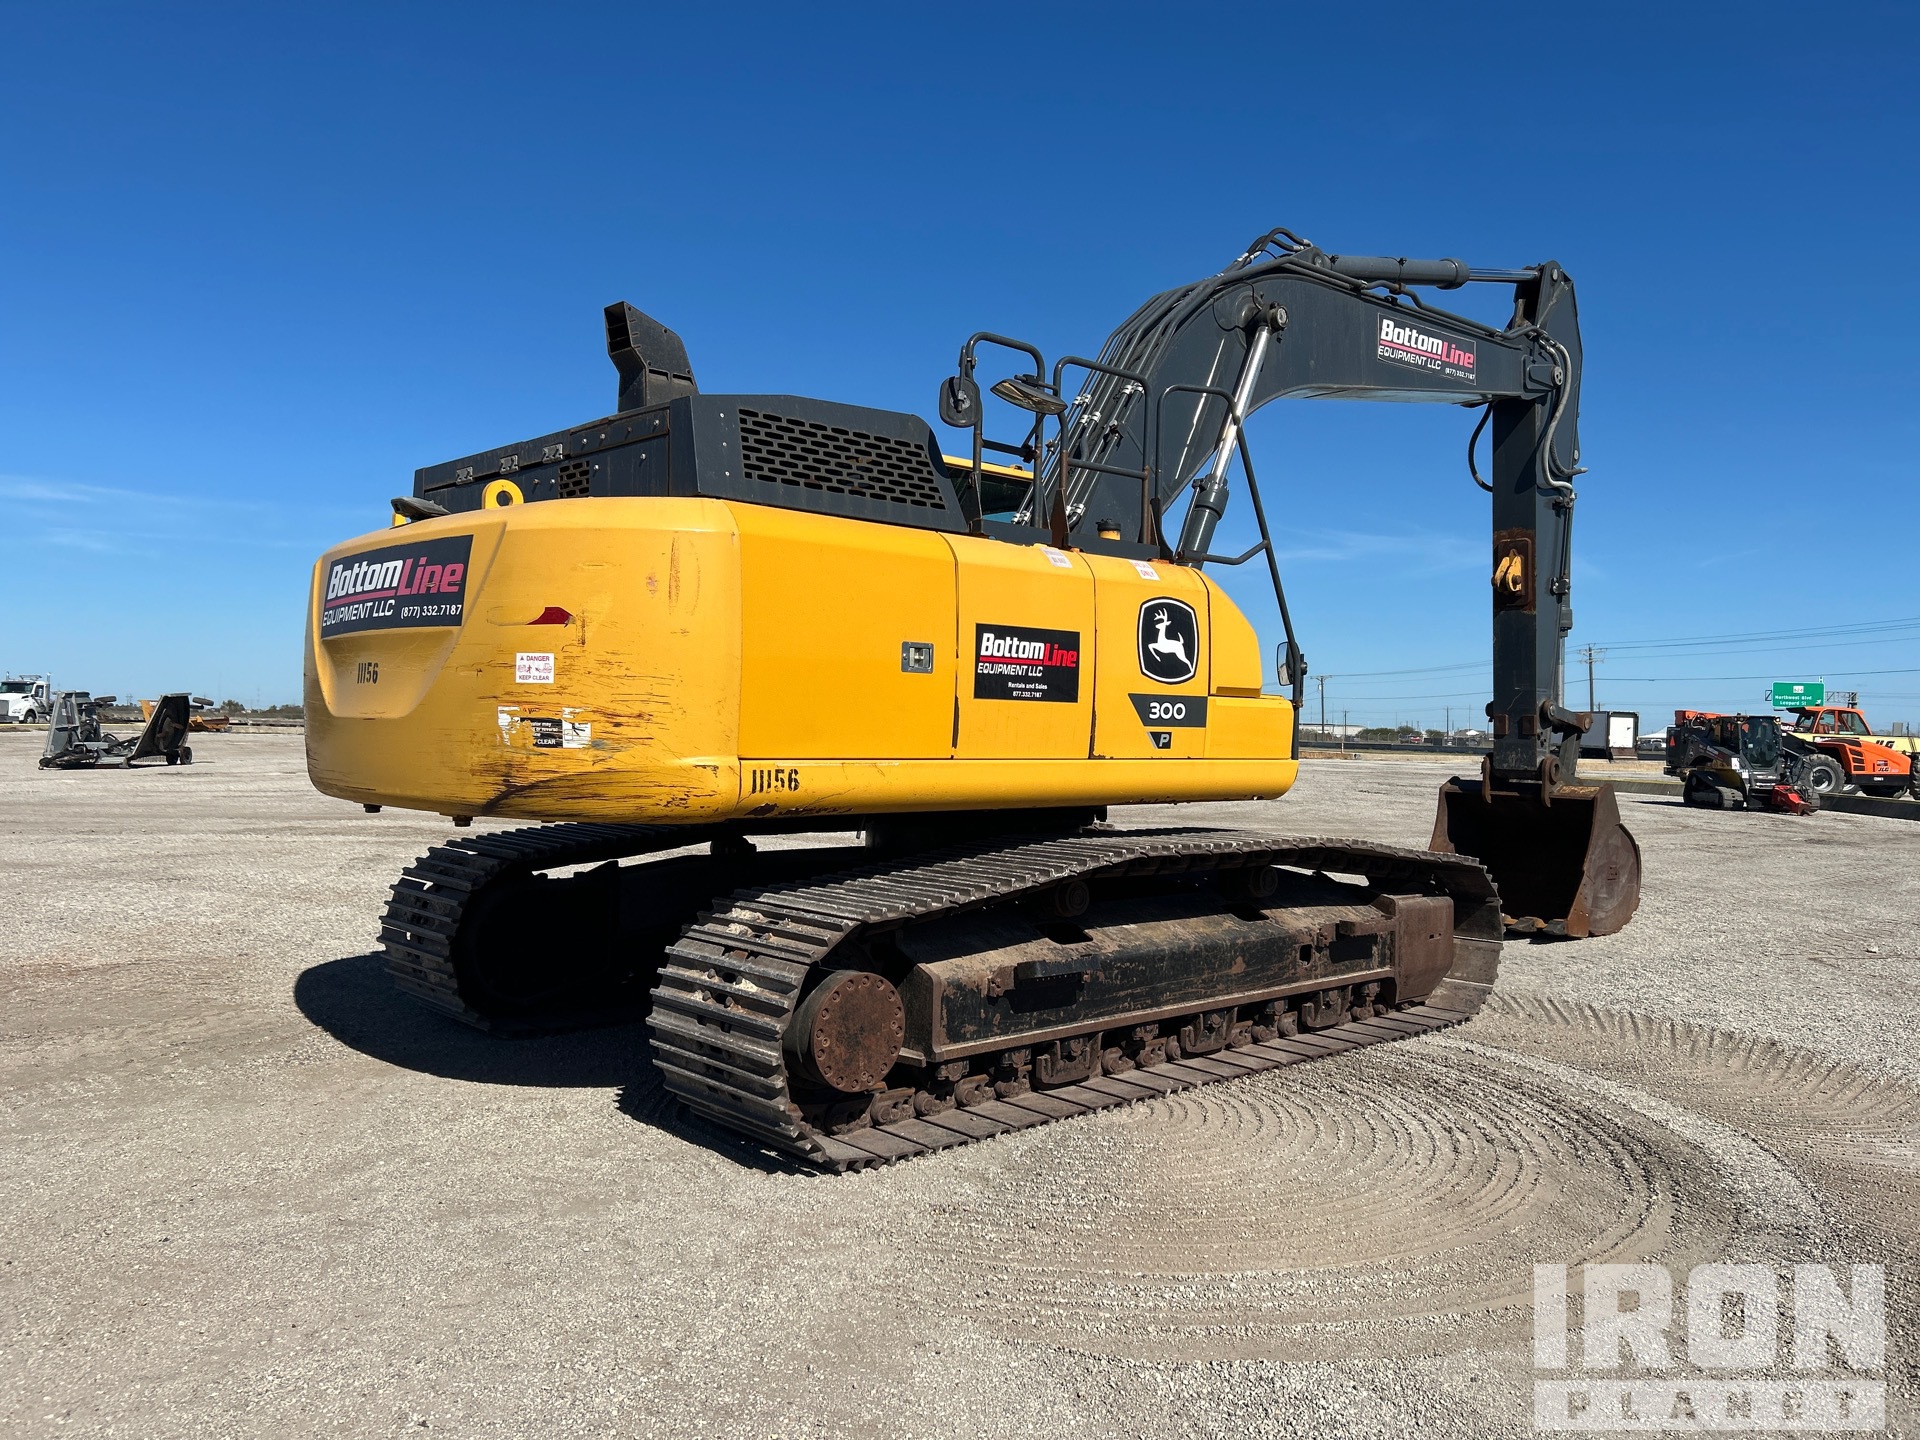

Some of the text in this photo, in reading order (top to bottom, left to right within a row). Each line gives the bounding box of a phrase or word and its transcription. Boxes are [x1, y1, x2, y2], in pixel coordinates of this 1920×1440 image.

[1380, 319, 1474, 368] BottomLine
[1378, 345, 1442, 370] EQUIPMENT LLC
[1445, 367, 1476, 380] (877) 332.7187
[327, 557, 465, 600] BottomLine
[323, 600, 395, 627] EQUIPMENT LLC
[401, 604, 462, 619] (877) 332.7187
[980, 633, 1077, 668] BottomLine
[357, 662, 379, 684] 11156
[977, 662, 1044, 677] EQUIPMENT LLC
[1026, 682, 1035, 690] and
[1149, 702, 1186, 720] 300
[1159, 733, 1170, 747] P
[751, 769, 800, 794] 11156
